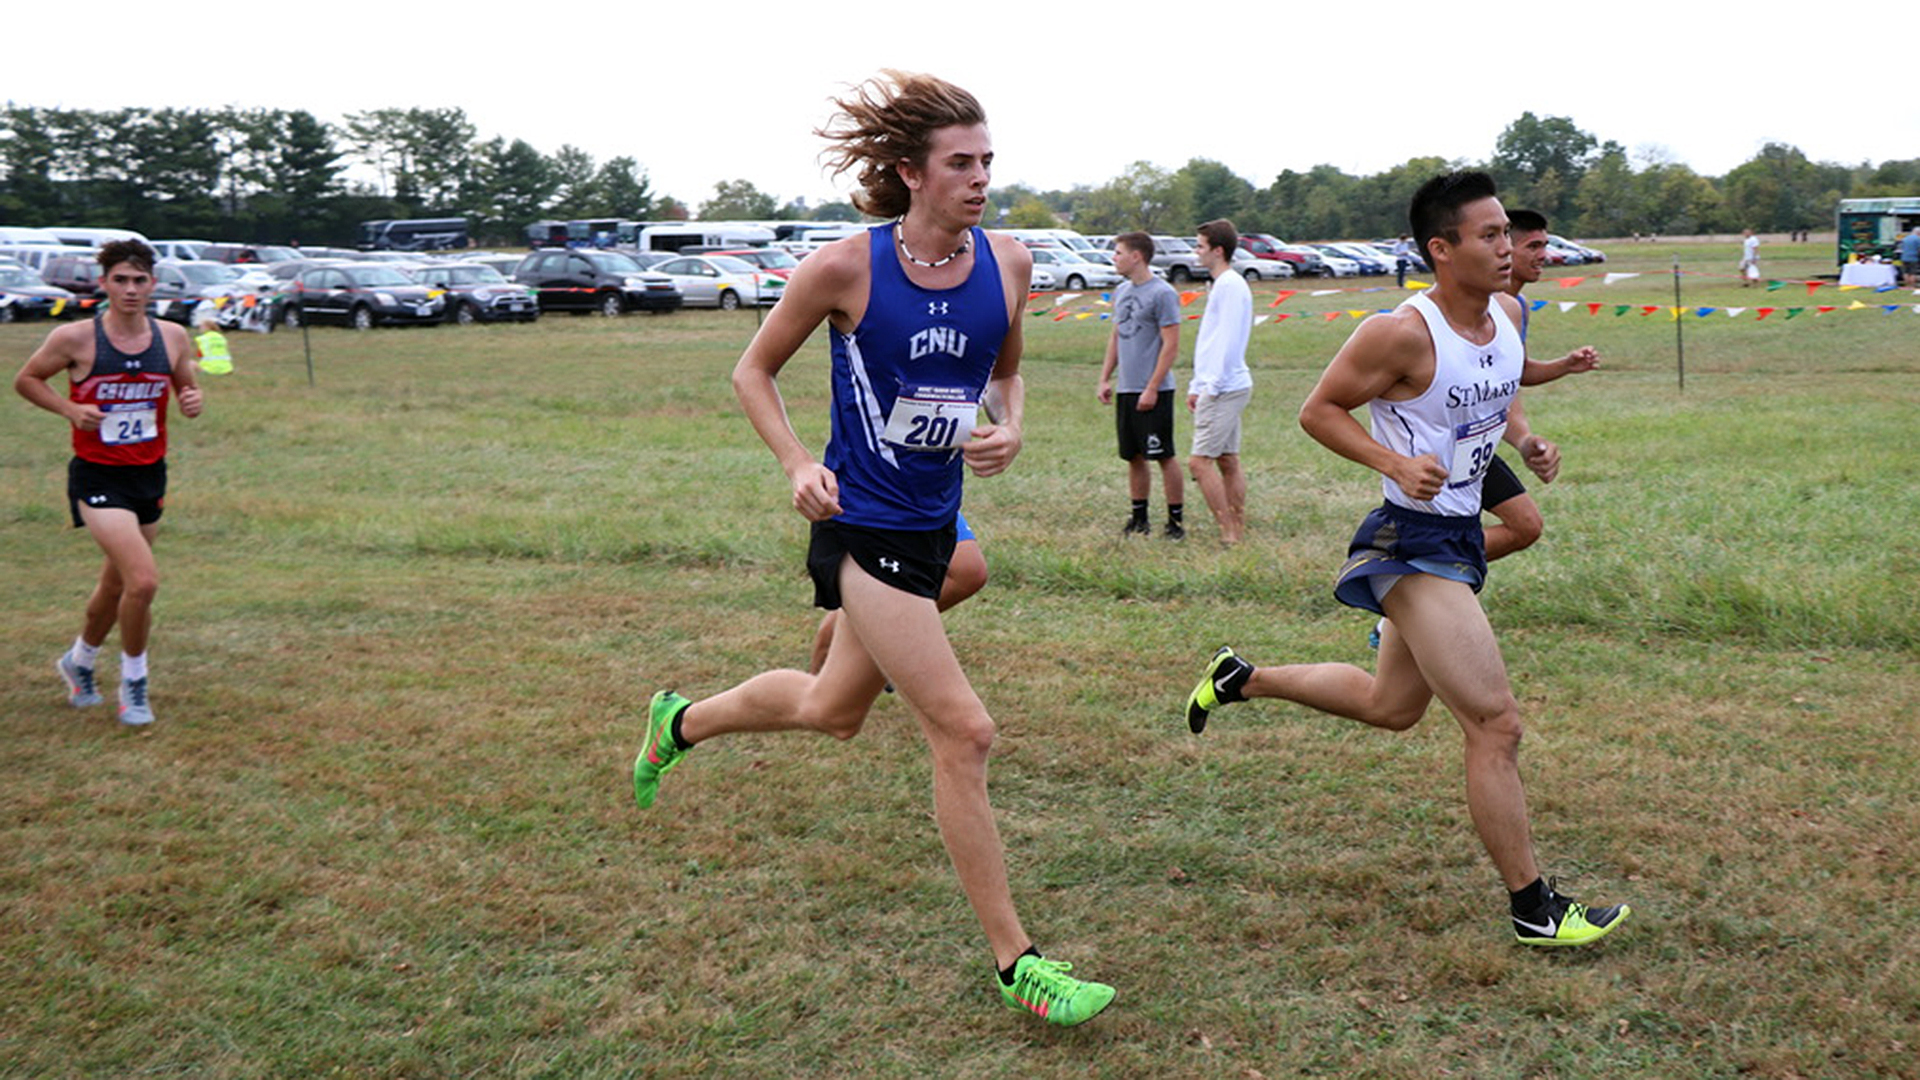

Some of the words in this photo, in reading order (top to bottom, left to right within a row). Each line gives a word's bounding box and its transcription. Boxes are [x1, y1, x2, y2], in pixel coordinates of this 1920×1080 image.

[909, 326, 968, 361] CNU
[96, 381, 166, 400] CATHOLIC
[118, 419, 142, 439] 24
[904, 415, 959, 447] 201
[1469, 441, 1493, 476] 39
